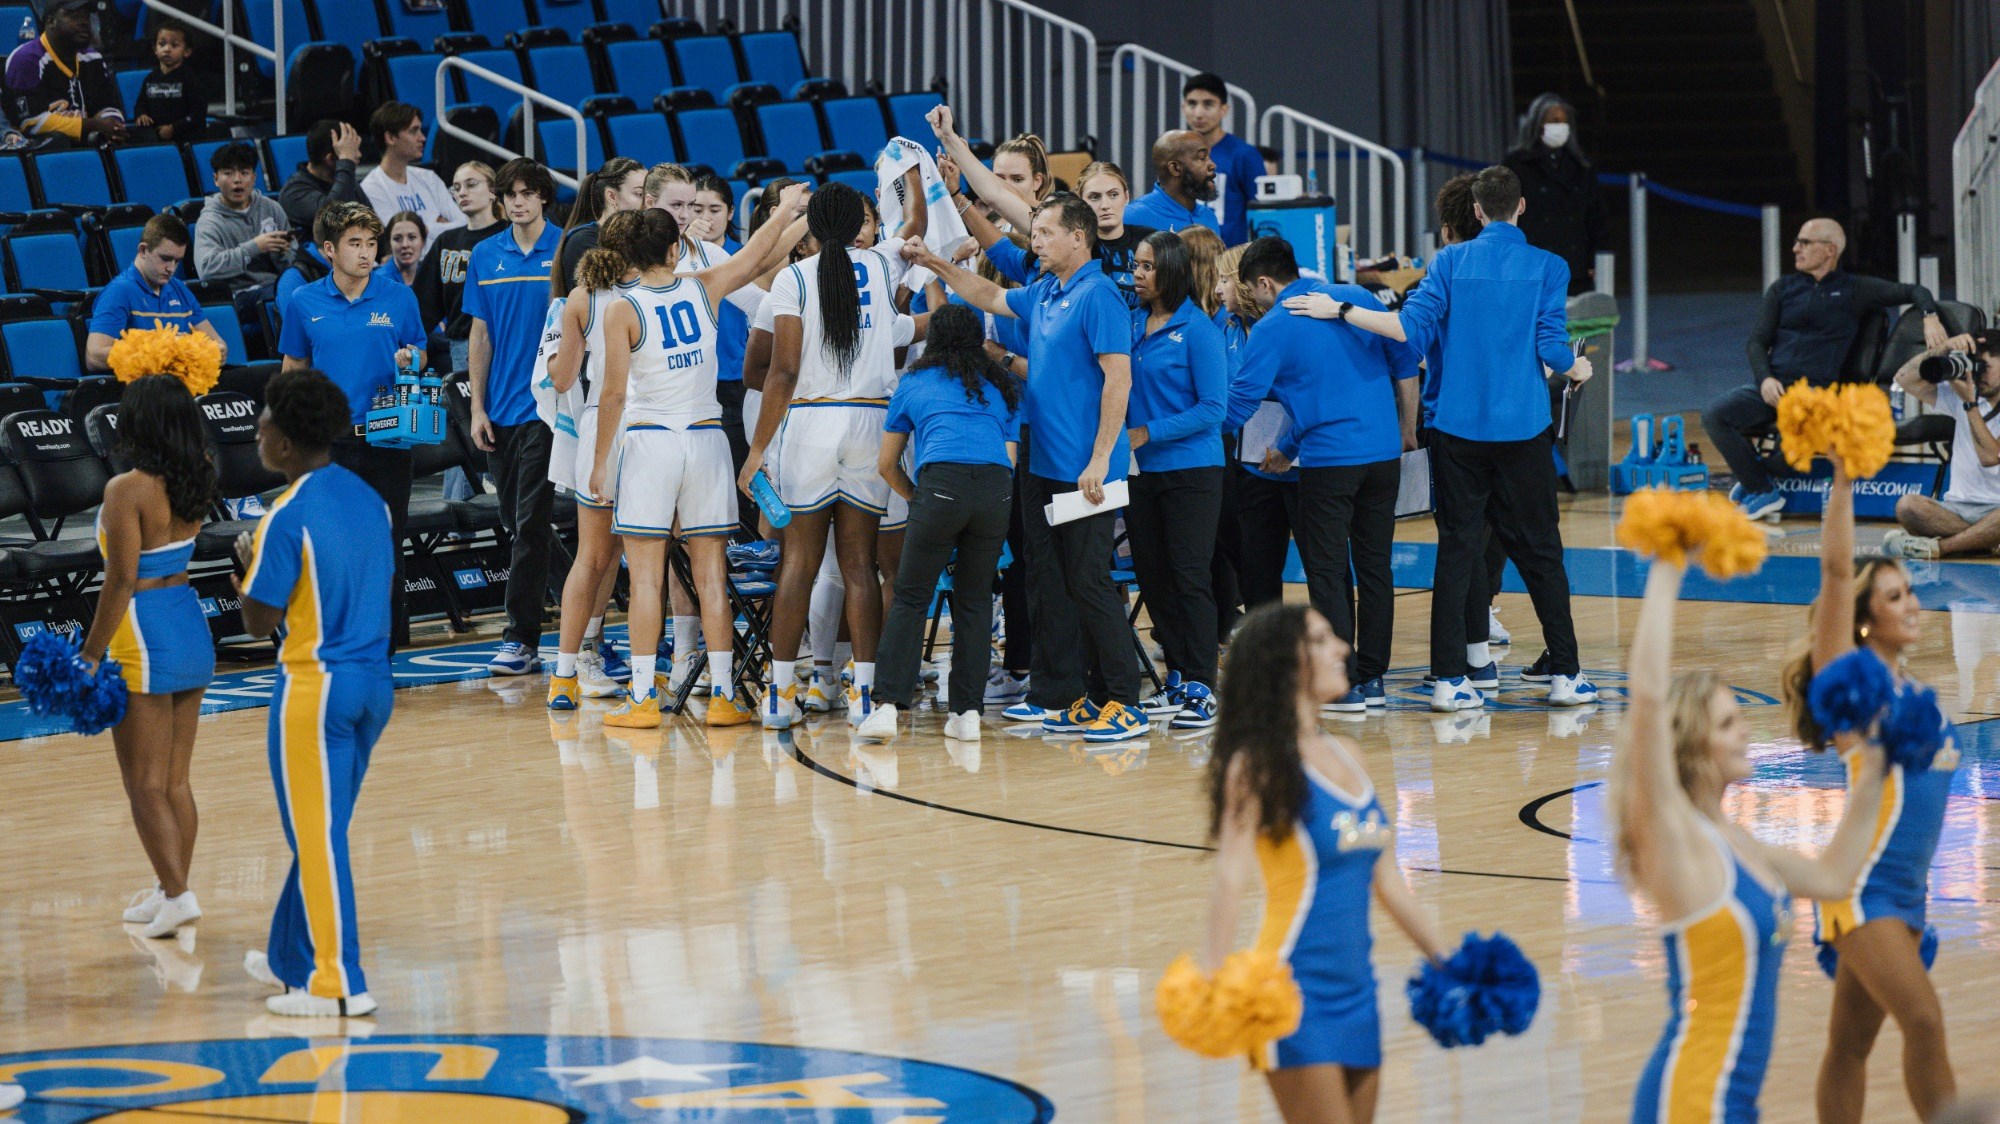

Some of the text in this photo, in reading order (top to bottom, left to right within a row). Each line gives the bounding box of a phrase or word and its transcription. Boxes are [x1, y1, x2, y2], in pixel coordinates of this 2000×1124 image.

[441, 249, 472, 284] UC
[852, 262, 872, 306] 2
[655, 300, 702, 350] 10
[668, 348, 704, 370] CONTI
[201, 400, 255, 420] READY
[17, 418, 72, 438] READY
[368, 417, 398, 431] POWERADE
[1775, 477, 1813, 493] SCOM
[1851, 480, 1908, 496] WESCOM
[458, 568, 511, 585] UCLA Healt
[200, 596, 242, 614] LA Heal
[47, 618, 84, 635] Health
